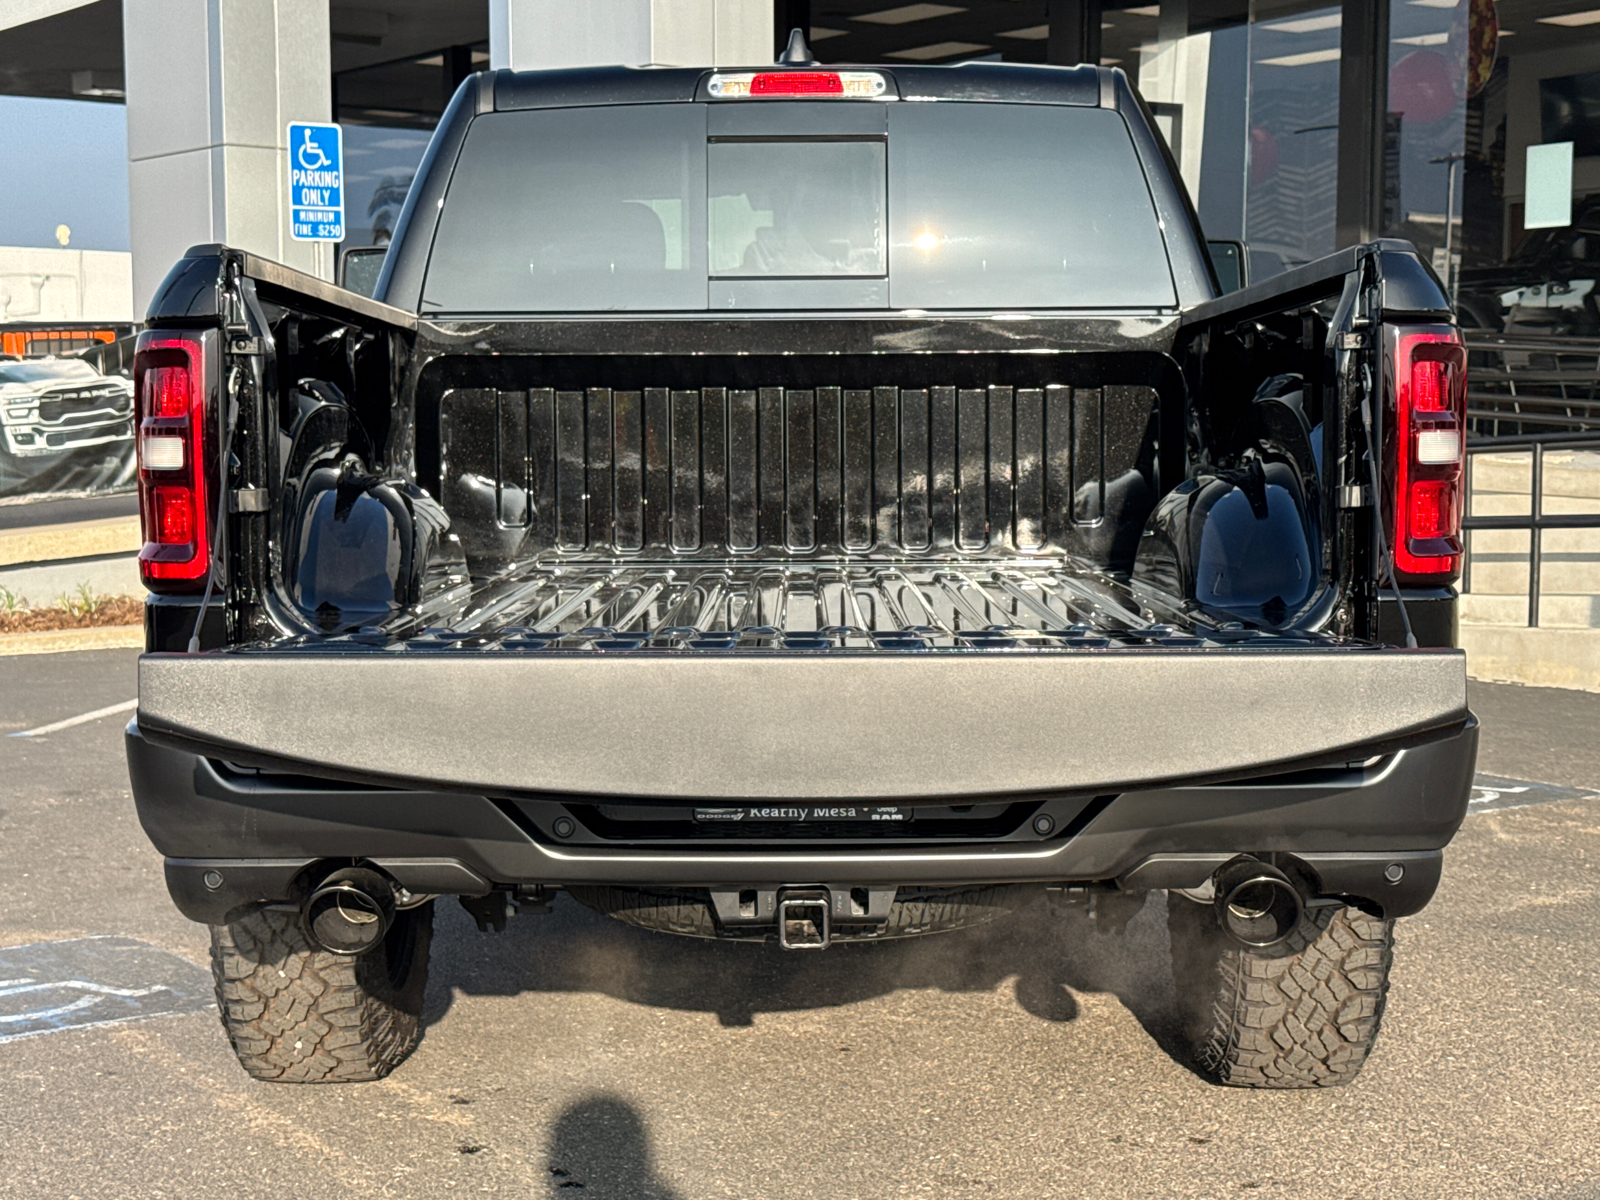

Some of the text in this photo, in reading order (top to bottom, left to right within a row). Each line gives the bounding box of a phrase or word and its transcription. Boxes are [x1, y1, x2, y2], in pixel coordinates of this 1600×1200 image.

[293, 169, 339, 188] PARKING
[302, 188, 330, 205] ONLY
[300, 211, 334, 222] MINIMUM
[295, 223, 340, 236] FINE $250
[750, 807, 857, 821] Kearny Mesa
